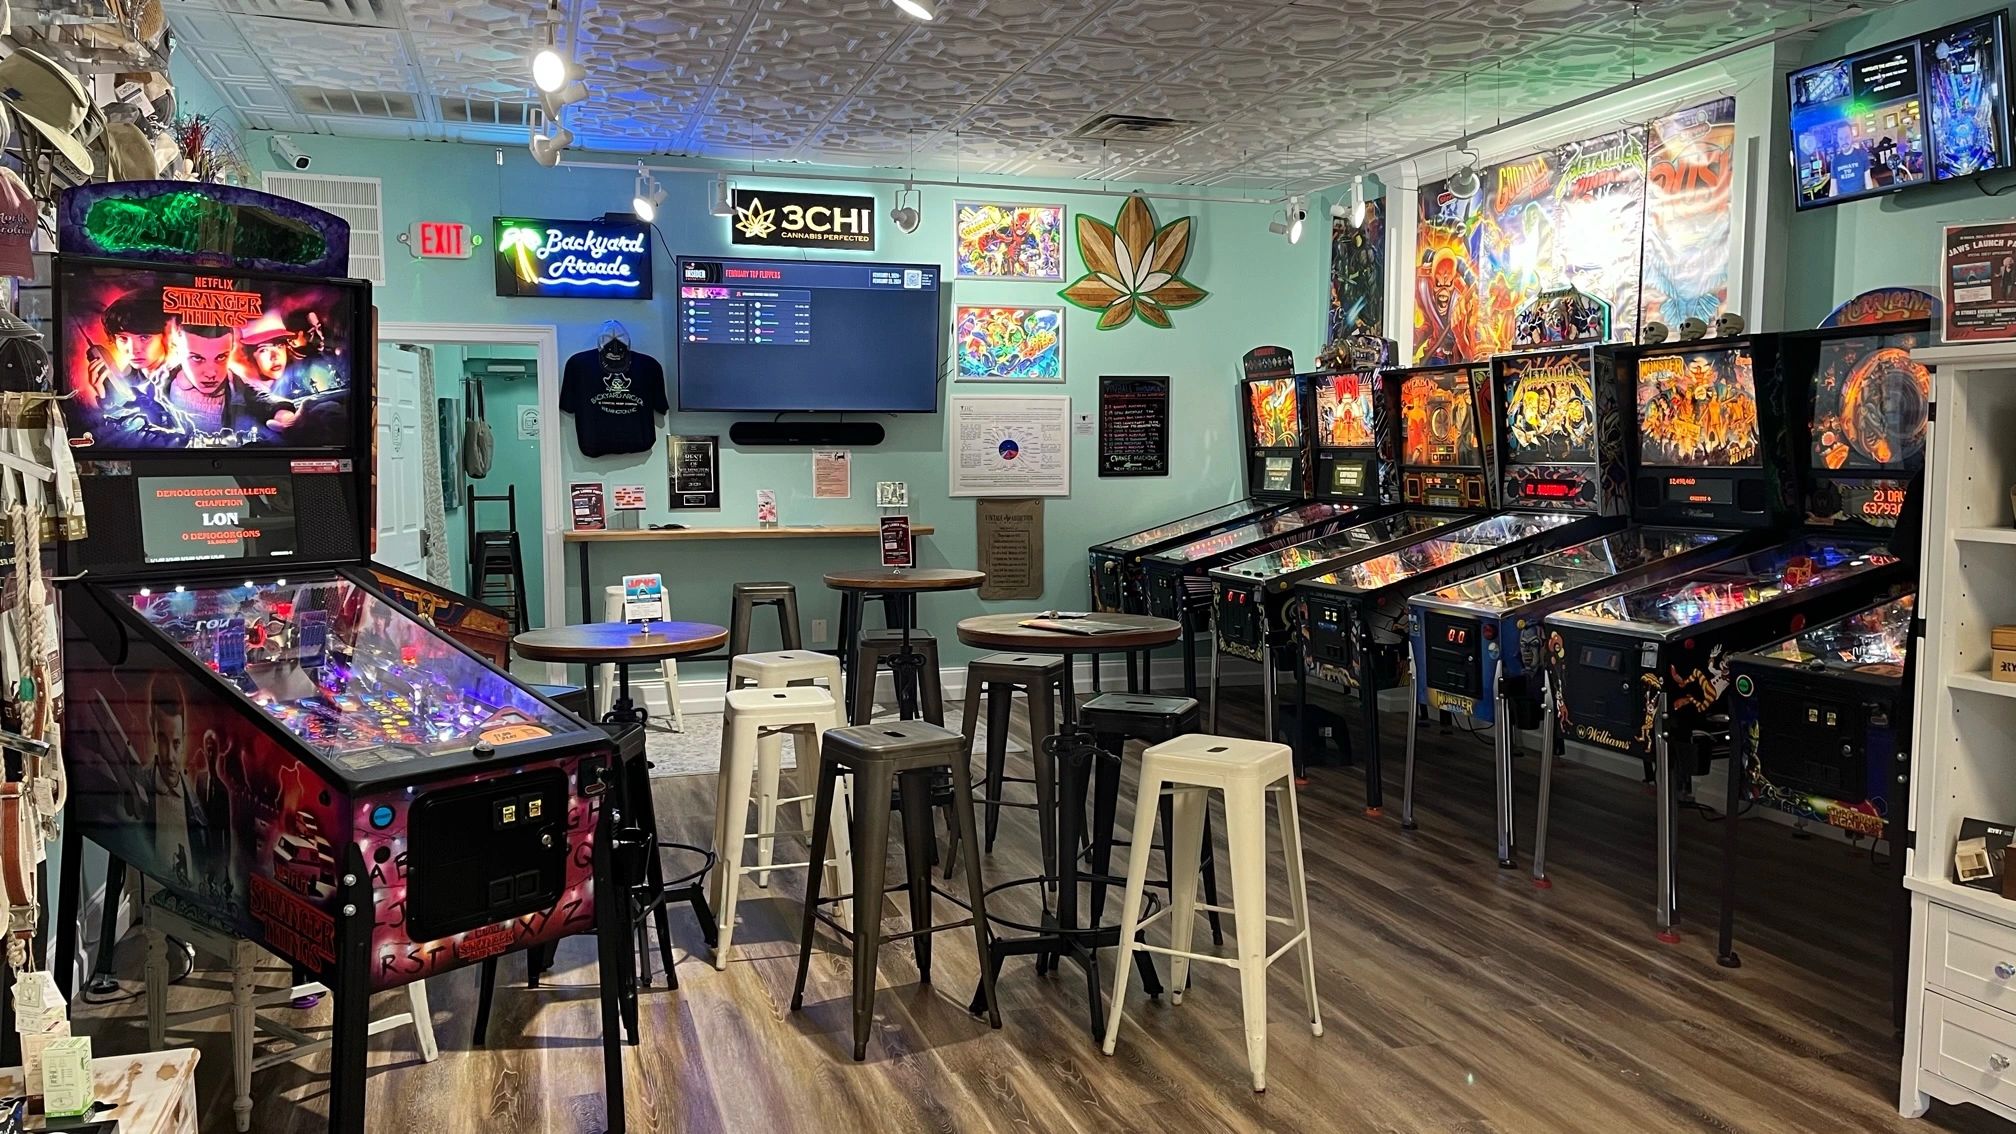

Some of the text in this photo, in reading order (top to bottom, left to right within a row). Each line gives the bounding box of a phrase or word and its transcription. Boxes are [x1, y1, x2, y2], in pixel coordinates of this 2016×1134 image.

[1494, 155, 1548, 213] GODZILLA
[781, 205, 871, 234] 3CHI
[0, 226, 31, 236] rolina
[421, 224, 463, 254] EXIT
[781, 232, 870, 242] CANNABIS PERFECTED
[536, 229, 644, 260] Backyard
[1948, 244, 1971, 257] JAWS
[1973, 239, 2005, 250] LAUNCH
[549, 256, 631, 277] Arcade
[725, 269, 749, 278] FEBRUARY
[195, 276, 233, 290] NETFLIX
[162, 288, 263, 317] STRANGER
[180, 308, 248, 328] THINGS
[1639, 358, 1684, 380] MONSTER
[156, 486, 277, 498] DEMOGORGON CHALLENGE
[195, 499, 243, 508] CHAMPION
[202, 512, 239, 526] LON
[190, 529, 261, 540] DEMOGORGONS
[628, 578, 657, 588] JAWS
[1436, 690, 1474, 713] MONSTER
[1587, 726, 1632, 750] Williams
[249, 875, 336, 961] STRANGER
